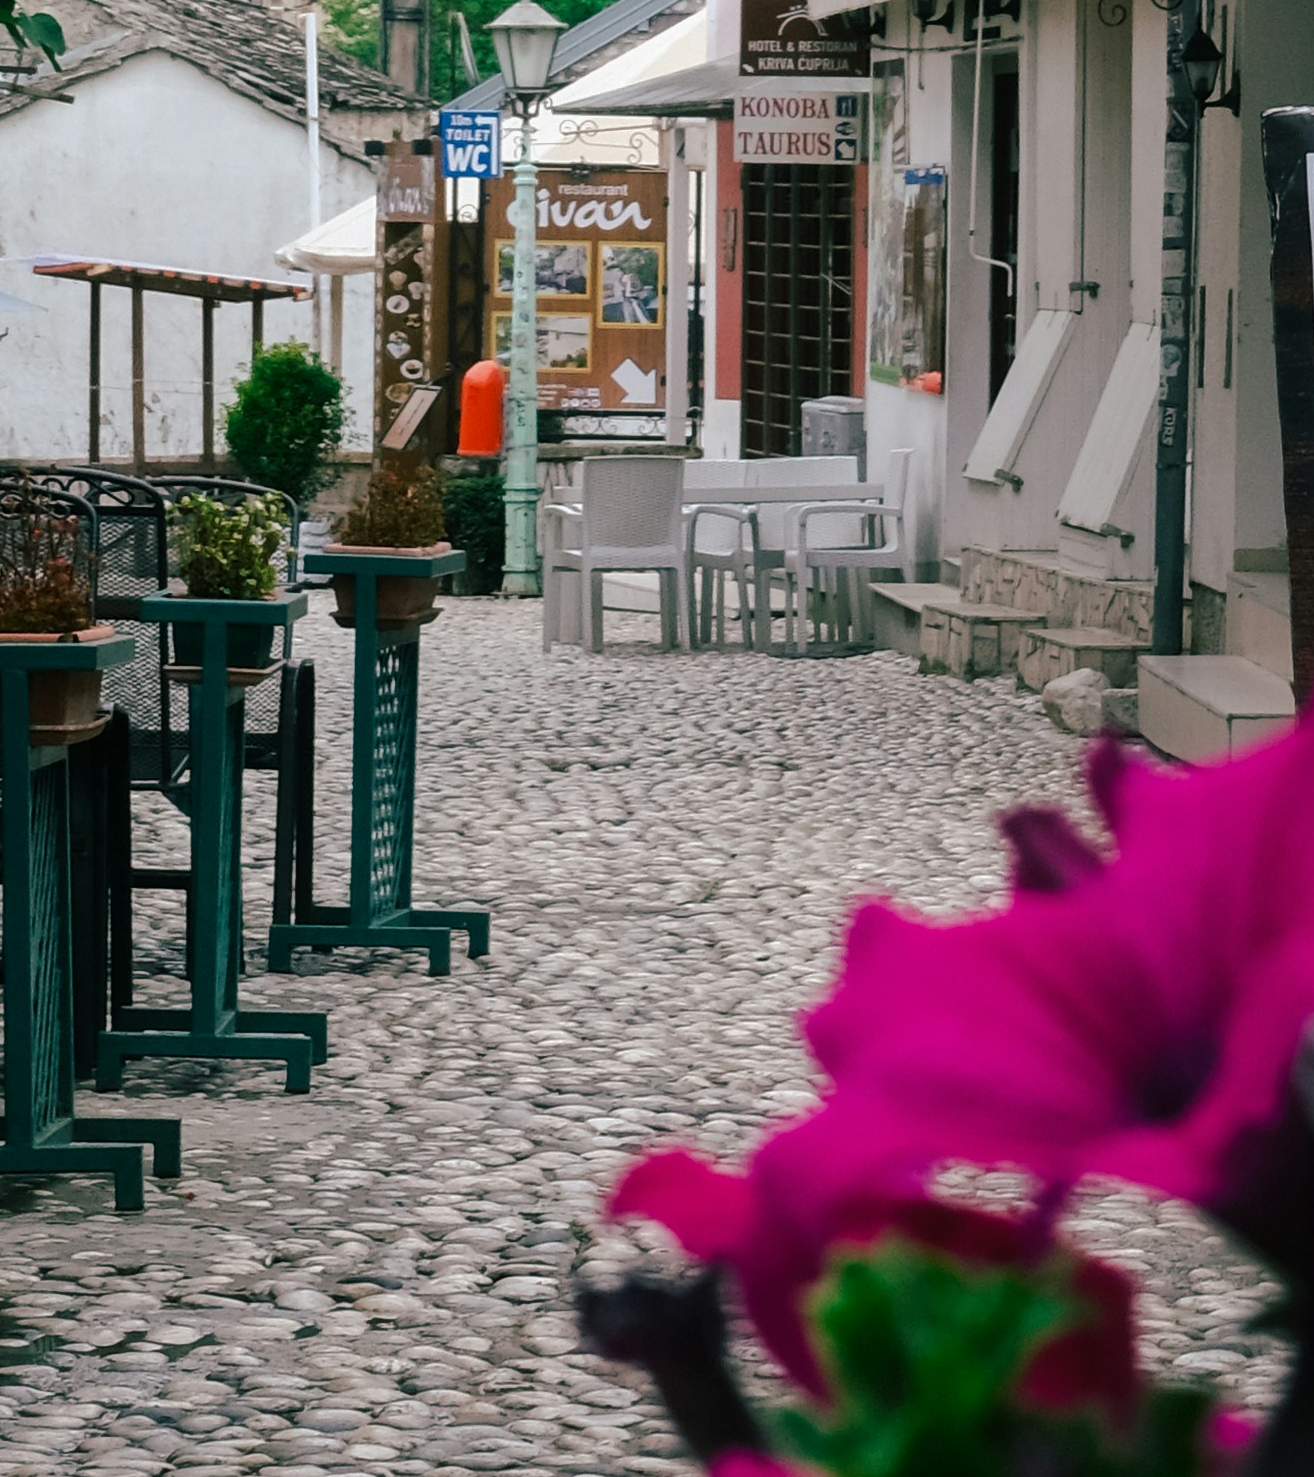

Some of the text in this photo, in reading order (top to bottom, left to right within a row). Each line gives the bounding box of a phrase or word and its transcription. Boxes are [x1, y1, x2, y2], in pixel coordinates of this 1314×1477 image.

[748, 40, 783, 52] HOTEL
[758, 57, 795, 70] KRIVA
[740, 97, 830, 119] KONOBA
[445, 129, 491, 143] TOILET
[738, 132, 832, 156] TAURUS
[446, 144, 489, 173] WC
[558, 183, 629, 196] restaurant
